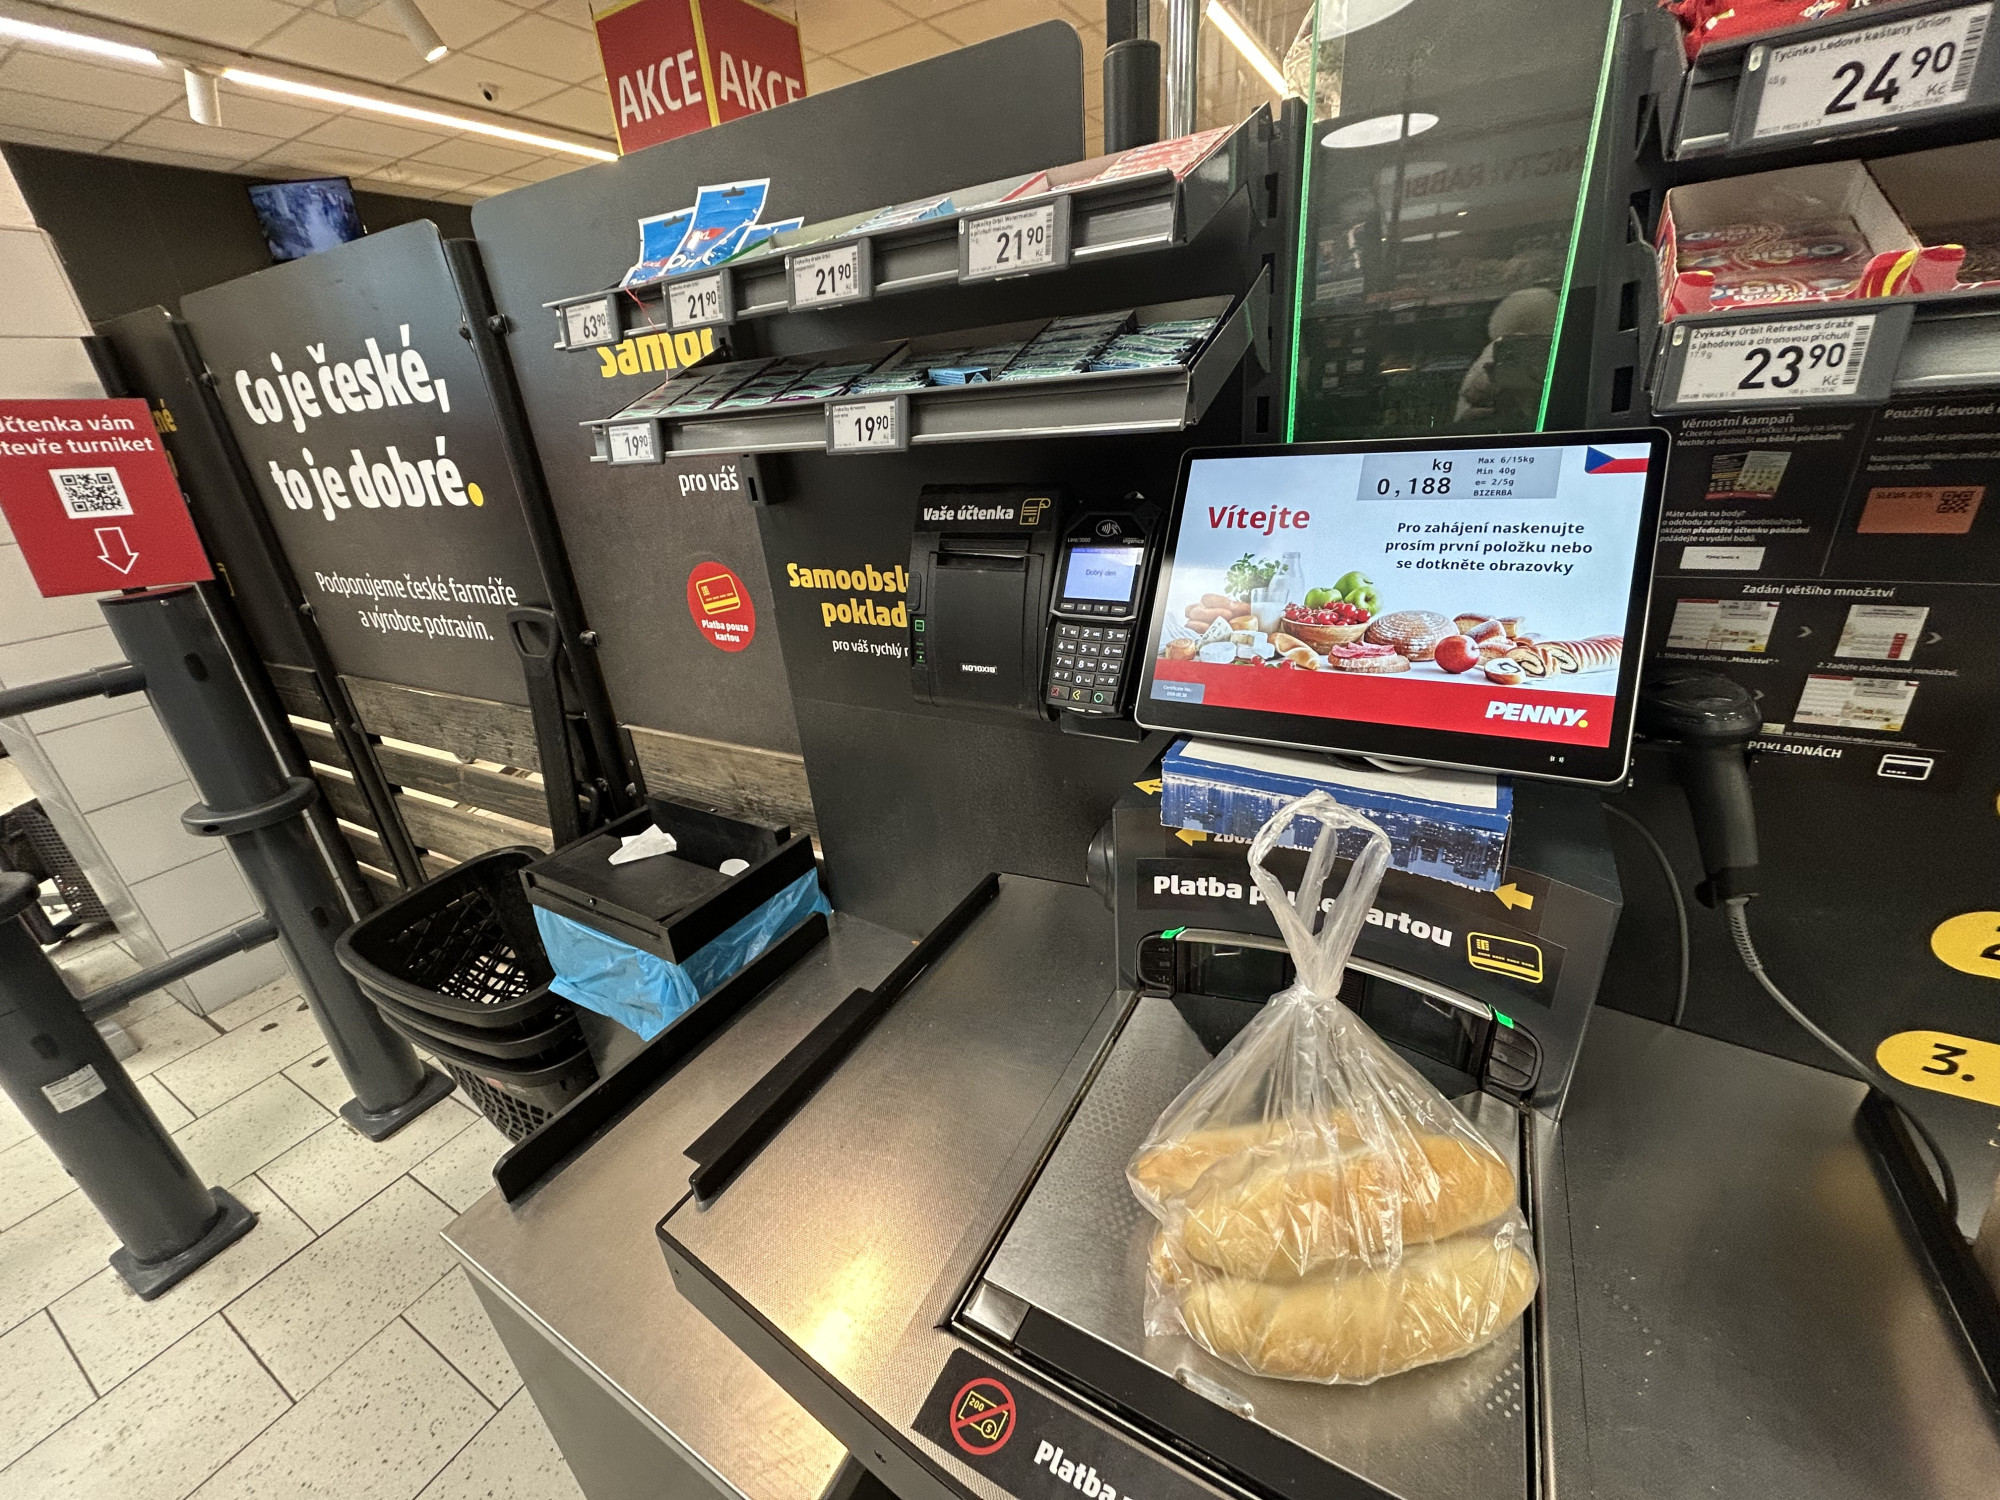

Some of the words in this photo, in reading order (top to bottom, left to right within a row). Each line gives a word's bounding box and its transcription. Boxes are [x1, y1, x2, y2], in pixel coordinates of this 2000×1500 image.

[1819, 34, 1862, 51] Ledové
[1915, 16, 1952, 31] Orion
[619, 49, 702, 128] AKCE
[1694, 326, 1736, 339] Žvýkačky
[1739, 324, 1764, 336] Orbit
[1766, 322, 1821, 334] Refreshers
[1825, 320, 1854, 329] dražé
[1698, 338, 1747, 351] jahodovou
[1757, 334, 1809, 345] citronovou
[235, 369, 283, 425] Co
[270, 351, 322, 433] je
[306, 324, 451, 413] české,
[1822, 374, 1839, 387] Kč
[1884, 405, 1936, 419] Použití
[1936, 403, 1995, 417] slevové
[87, 414, 135, 432] vám
[1682, 415, 1739, 429] Věrnostní
[1741, 413, 1795, 426] kampaň
[0, 438, 63, 456] tevře
[66, 436, 155, 454] turniket
[1432, 458, 1453, 474] kg
[1478, 456, 1496, 464] Max
[1500, 455, 1535, 465] 6/15kg
[1476, 467, 1494, 475] Min
[1498, 467, 1516, 476] 40g
[268, 460, 314, 510] to
[302, 447, 352, 521] je
[679, 474, 707, 497] pro
[708, 466, 740, 491] váš
[1377, 477, 1451, 498] 0,188
[1492, 478, 1515, 487] 2/5g
[1473, 488, 1513, 497] BIZERBA
[923, 506, 955, 521] Vaše
[957, 505, 1014, 521] účtenka
[1208, 505, 1311, 536] Vítejte
[1397, 522, 1422, 534] Pro
[1424, 520, 1490, 536] zahájení
[1492, 522, 1585, 537] naskenujte
[1385, 540, 1436, 554] prosím
[1438, 540, 1479, 554] první
[1483, 541, 1547, 555] položku
[1550, 542, 1593, 554] nebo
[1396, 560, 1412, 570] se
[1416, 558, 1485, 572] dotkněte
[1489, 559, 1574, 575] obrazovky
[315, 571, 406, 603] Podporujeme
[407, 573, 449, 601] české
[448, 577, 519, 606] farmáře
[1741, 584, 1783, 594] Zadání
[1785, 585, 1832, 596] většího
[1833, 587, 1896, 598] množství
[359, 609, 370, 628] a
[371, 605, 423, 633] výrobce
[423, 614, 495, 641] potravin.
[701, 619, 726, 630] Platba
[725, 622, 749, 633] pouze
[714, 630, 741, 643] kartou
[832, 640, 850, 653] pro
[851, 638, 869, 653] váš
[870, 643, 902, 659] rychlý
[1153, 874, 1243, 899] Platba
[1364, 904, 1453, 948] artou
[1922, 1042, 1975, 1083] 3.
[968, 1397, 985, 1412] 200
[1033, 1440, 1117, 1500] Platba
